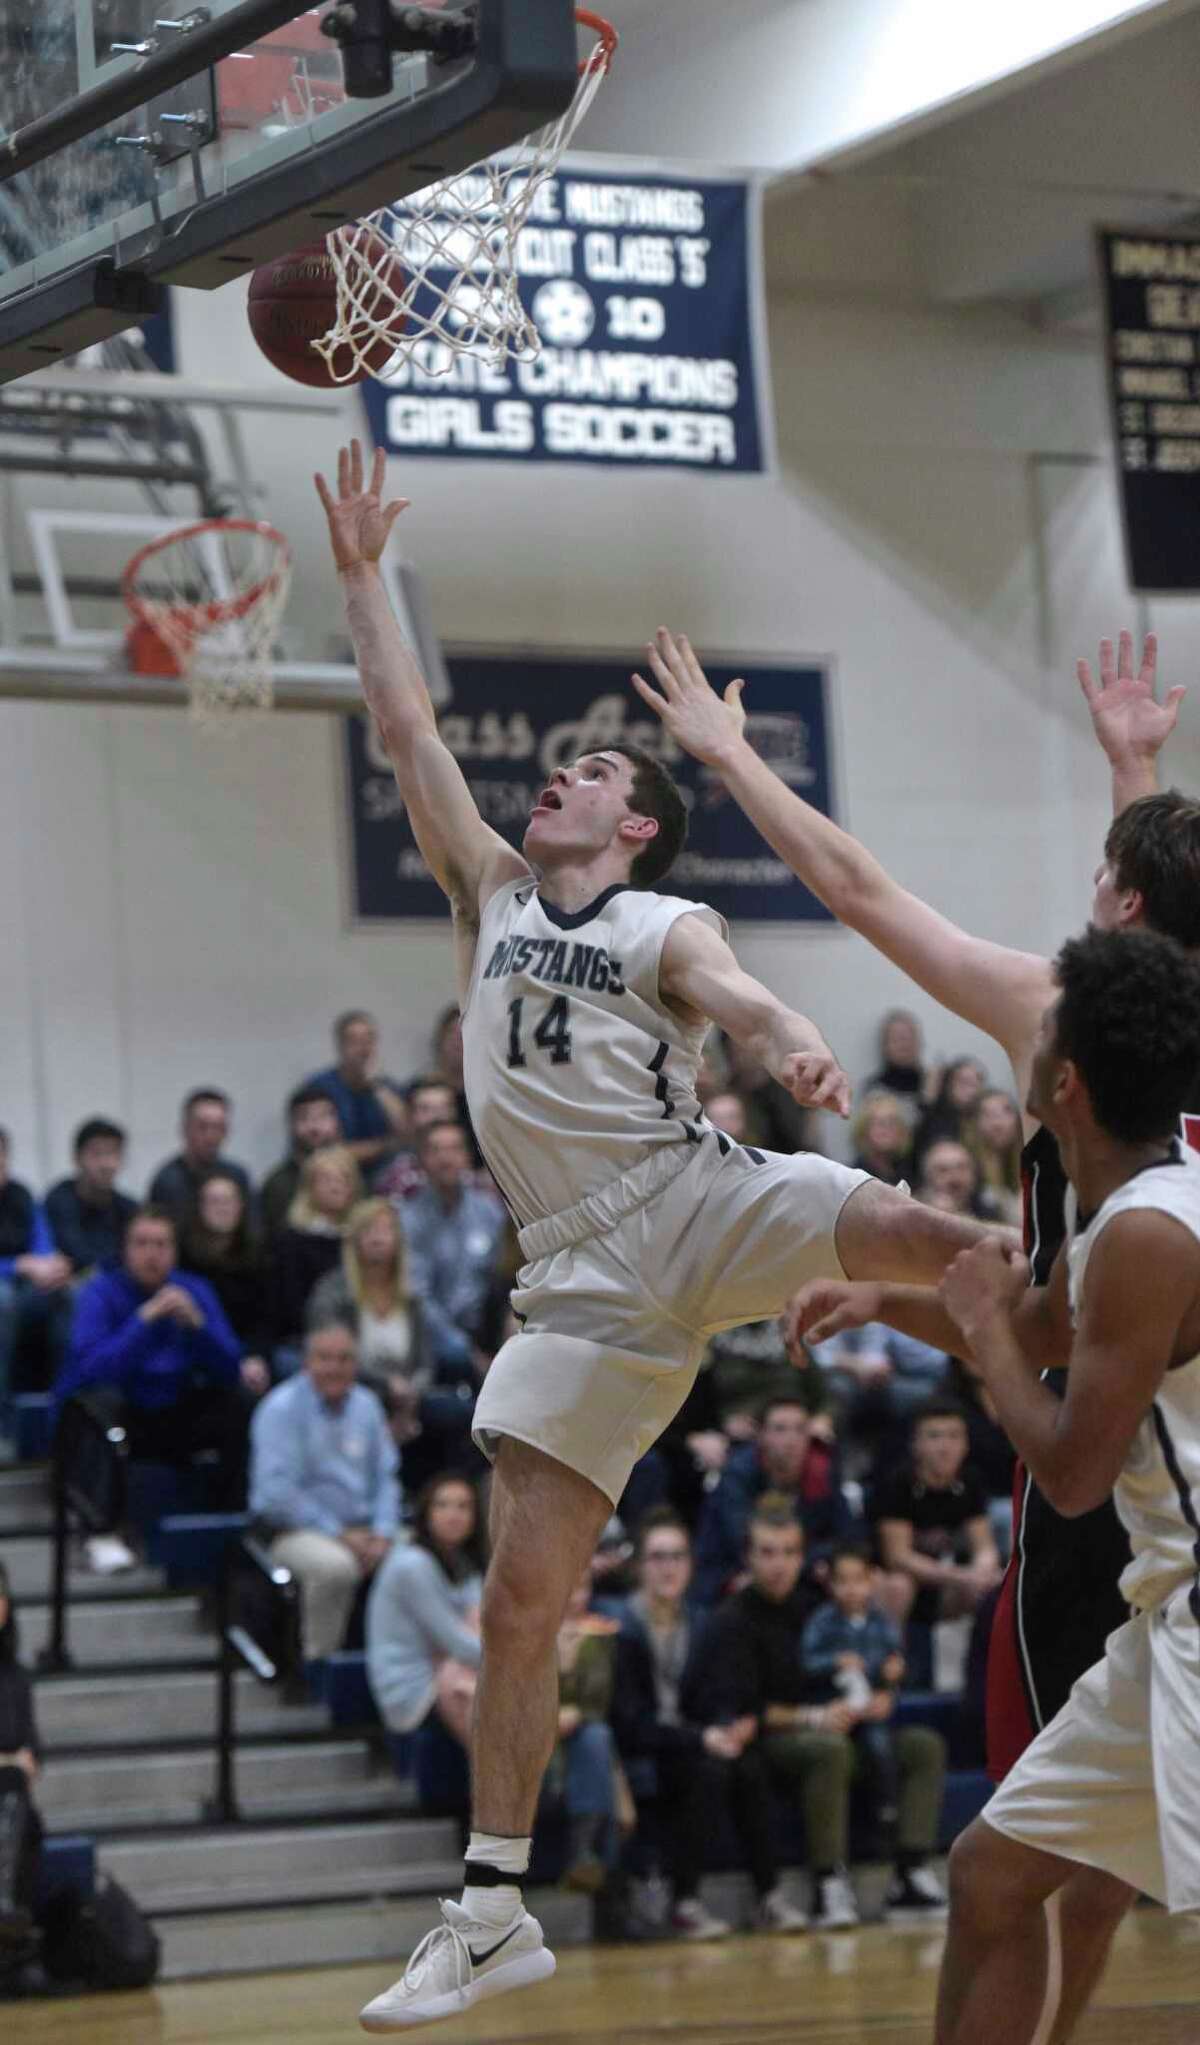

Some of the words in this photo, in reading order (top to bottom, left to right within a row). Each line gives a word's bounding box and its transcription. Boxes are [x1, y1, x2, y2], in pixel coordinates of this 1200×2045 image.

[566, 181, 704, 233] MUSTANGS
[584, 231, 675, 286] CLASS
[606, 295, 666, 341] 10
[518, 347, 738, 409] CHAMPIONS
[387, 396, 535, 451] GIRLS
[543, 402, 736, 464] SOCCER
[507, 995, 571, 1068] 14
